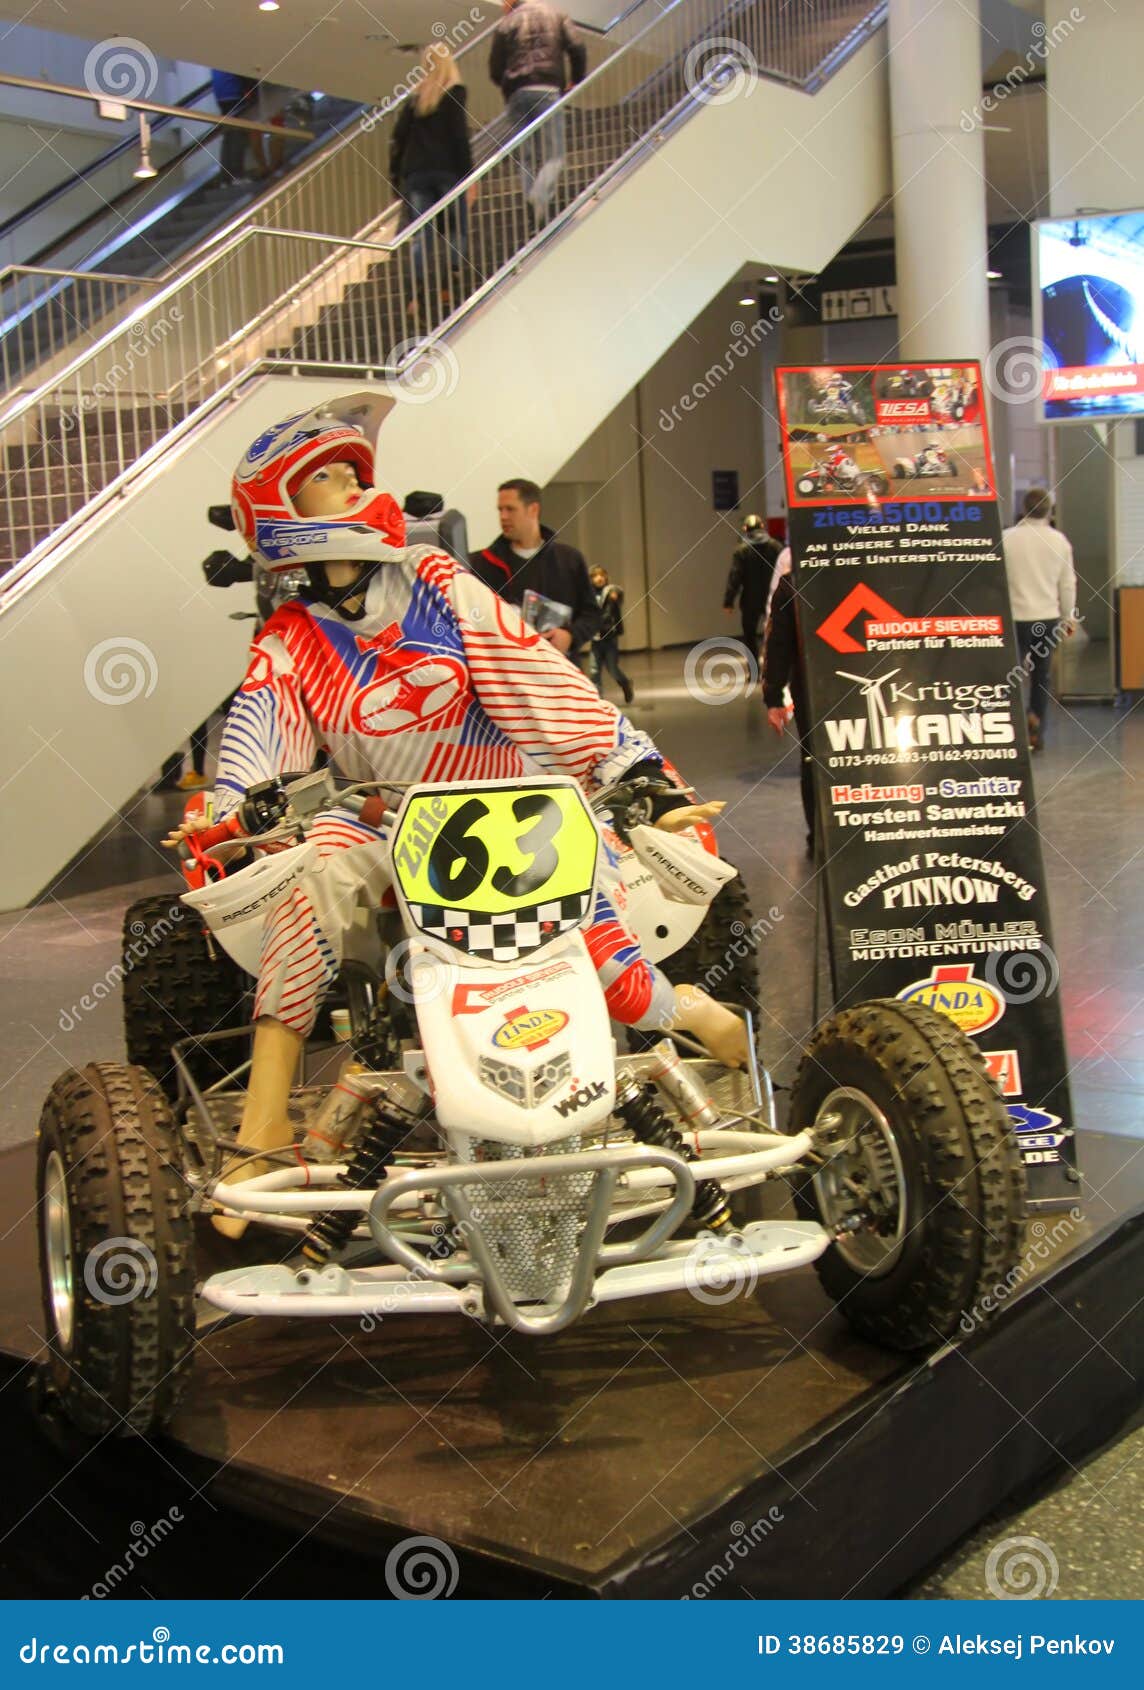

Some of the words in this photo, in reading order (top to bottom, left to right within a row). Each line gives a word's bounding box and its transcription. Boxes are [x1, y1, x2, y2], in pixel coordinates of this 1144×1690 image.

[812, 501, 983, 528] ziesa500.de
[847, 524, 900, 534] VIELEN
[906, 523, 949, 533] DANK
[806, 543, 827, 553] AN
[832, 540, 893, 551] UNSERE
[899, 537, 992, 549] SPONSOREN
[800, 556, 832, 568] FÜR
[835, 557, 861, 566] DIE
[868, 621, 931, 635] RUDOLF
[935, 618, 1000, 633] SIEVERS
[867, 638, 920, 652] Partner
[924, 637, 945, 649] für
[949, 635, 1004, 649] Technik
[889, 681, 1010, 709] Krüger
[831, 784, 925, 805] Heizung
[939, 777, 1022, 799] Sanitär
[834, 808, 921, 827] Torsten
[926, 802, 1025, 821] Sawatzki
[428, 793, 564, 901] 63
[864, 825, 1006, 842] Handwerksmeister
[843, 854, 920, 907] Gasthof
[925, 852, 1038, 901] Petersberg
[883, 876, 1001, 909] PINNOW
[222, 873, 296, 922] RACETECH
[850, 927, 926, 946] EGON
[936, 919, 1039, 941] MÜLLER
[851, 938, 1042, 961] MOTORENTUNING
[503, 1013, 555, 1040] LINDA
